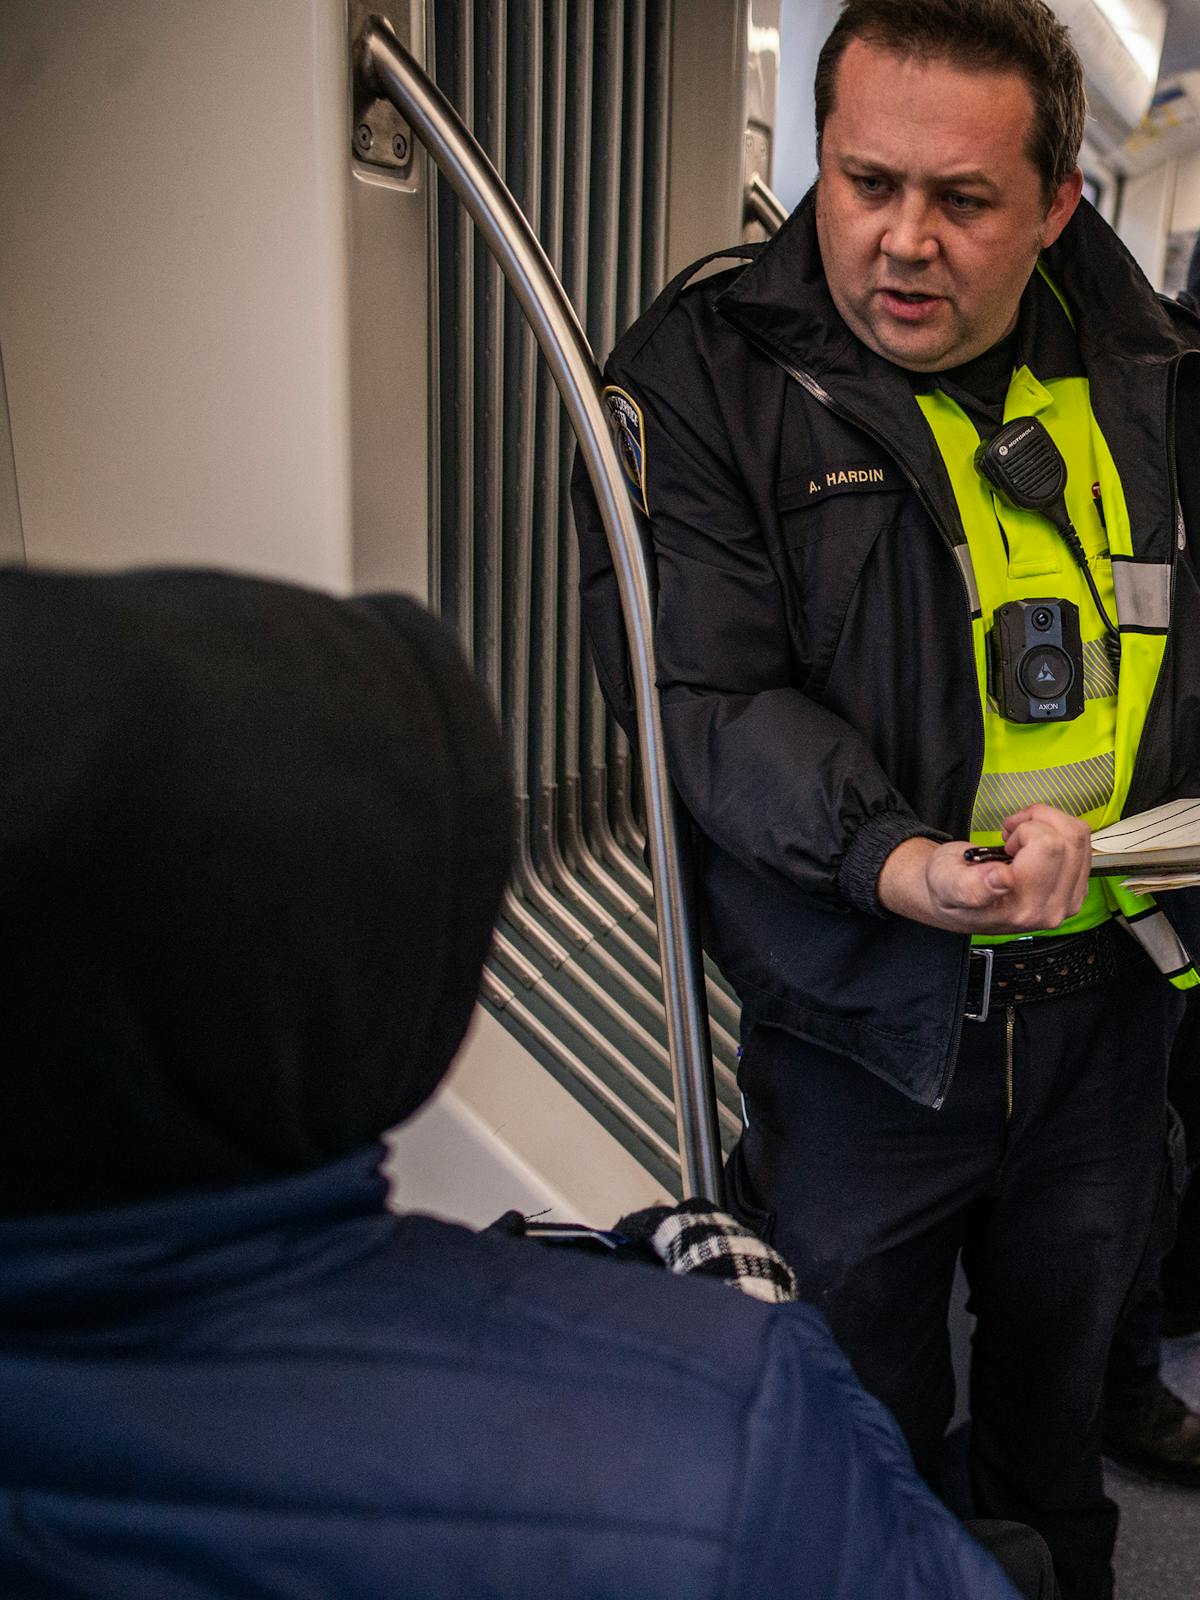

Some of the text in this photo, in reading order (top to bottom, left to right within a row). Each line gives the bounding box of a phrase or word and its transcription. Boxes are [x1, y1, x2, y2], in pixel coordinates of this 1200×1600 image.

[1008, 426, 1035, 448] MOTOROLA
[809, 469, 884, 494] A. HARDIN
[1038, 703, 1059, 711] AXON
